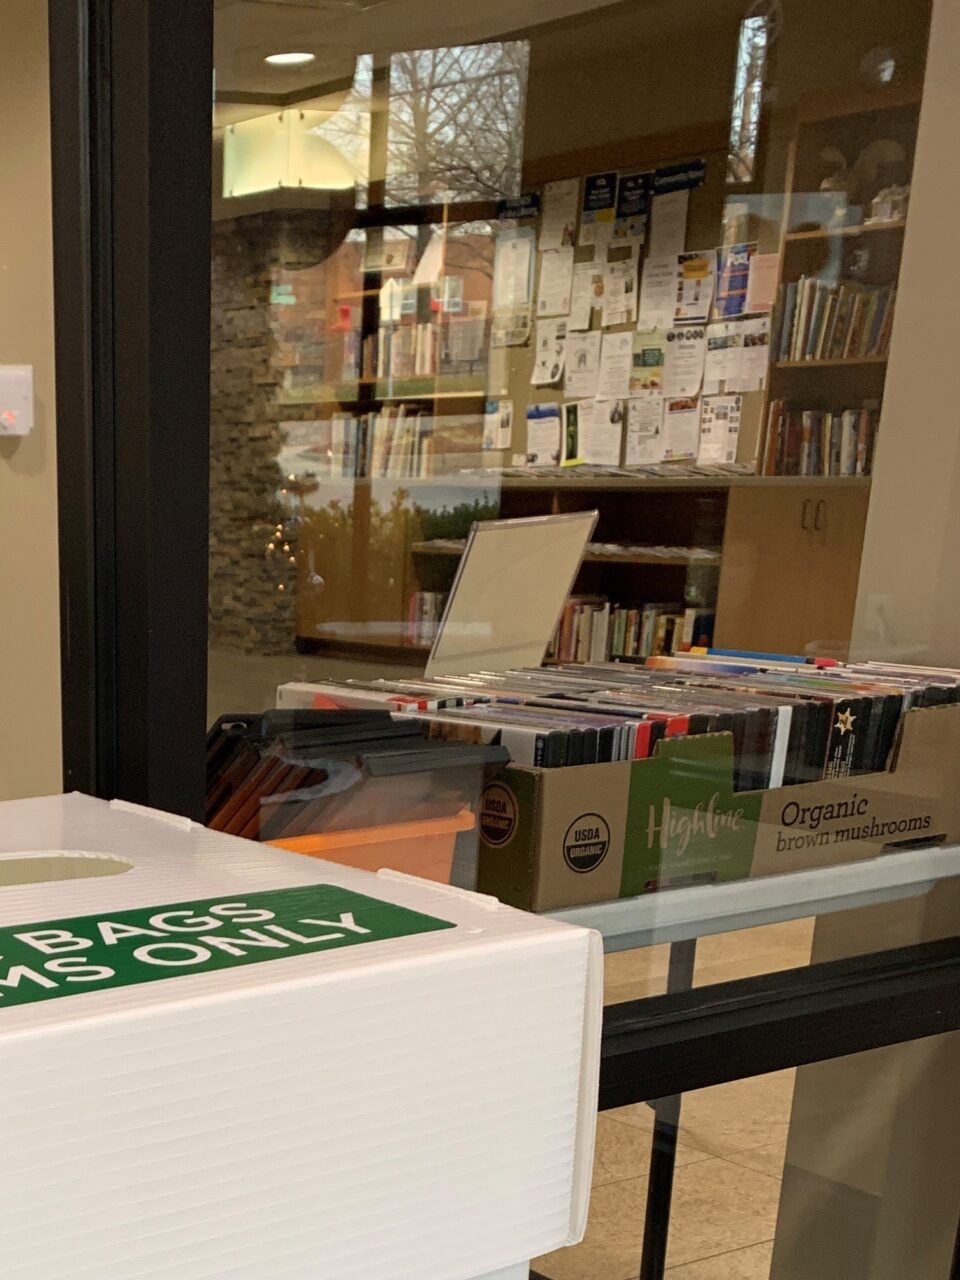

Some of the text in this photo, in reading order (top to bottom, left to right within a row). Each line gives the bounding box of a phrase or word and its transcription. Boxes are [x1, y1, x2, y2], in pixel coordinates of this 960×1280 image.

[485, 799, 508, 815] USDA
[645, 792, 745, 857] Highline
[781, 793, 869, 829] Organic
[569, 844, 603, 859] ORGANIC
[574, 827, 600, 843] USDA
[776, 815, 932, 852] brown mushrooms
[12, 902, 277, 956] BAGS
[132, 912, 372, 966] ONLY
